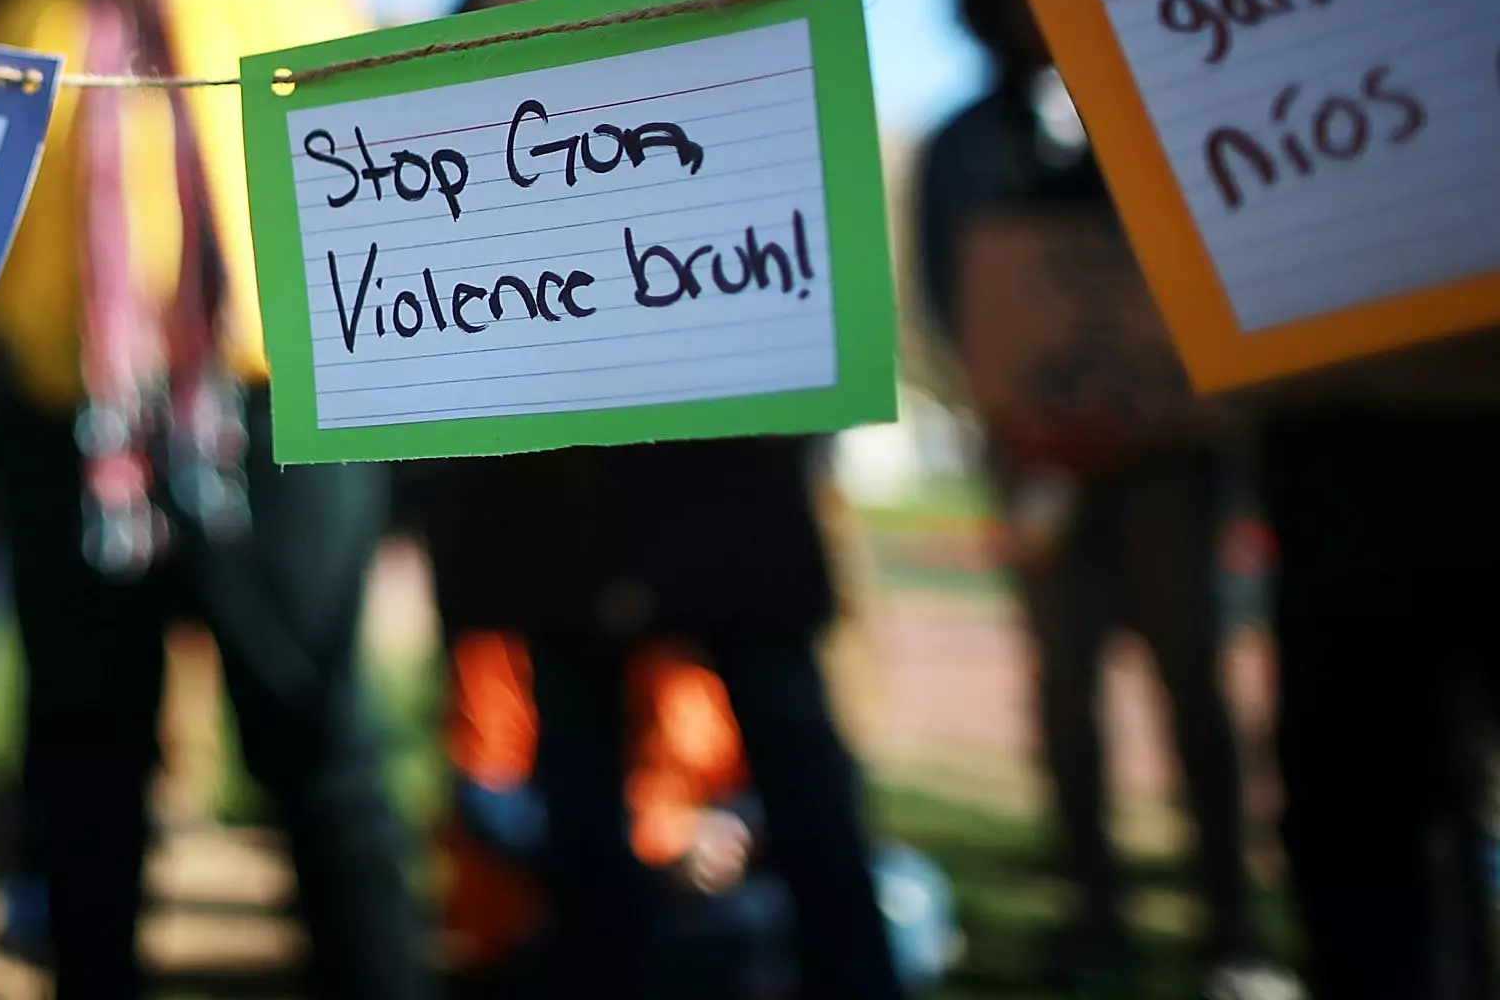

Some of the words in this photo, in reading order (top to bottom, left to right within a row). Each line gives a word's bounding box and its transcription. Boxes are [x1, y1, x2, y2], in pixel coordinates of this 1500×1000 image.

[303, 126, 470, 223] Stop
[327, 242, 597, 354] Violence
[624, 210, 814, 308] bruh!
